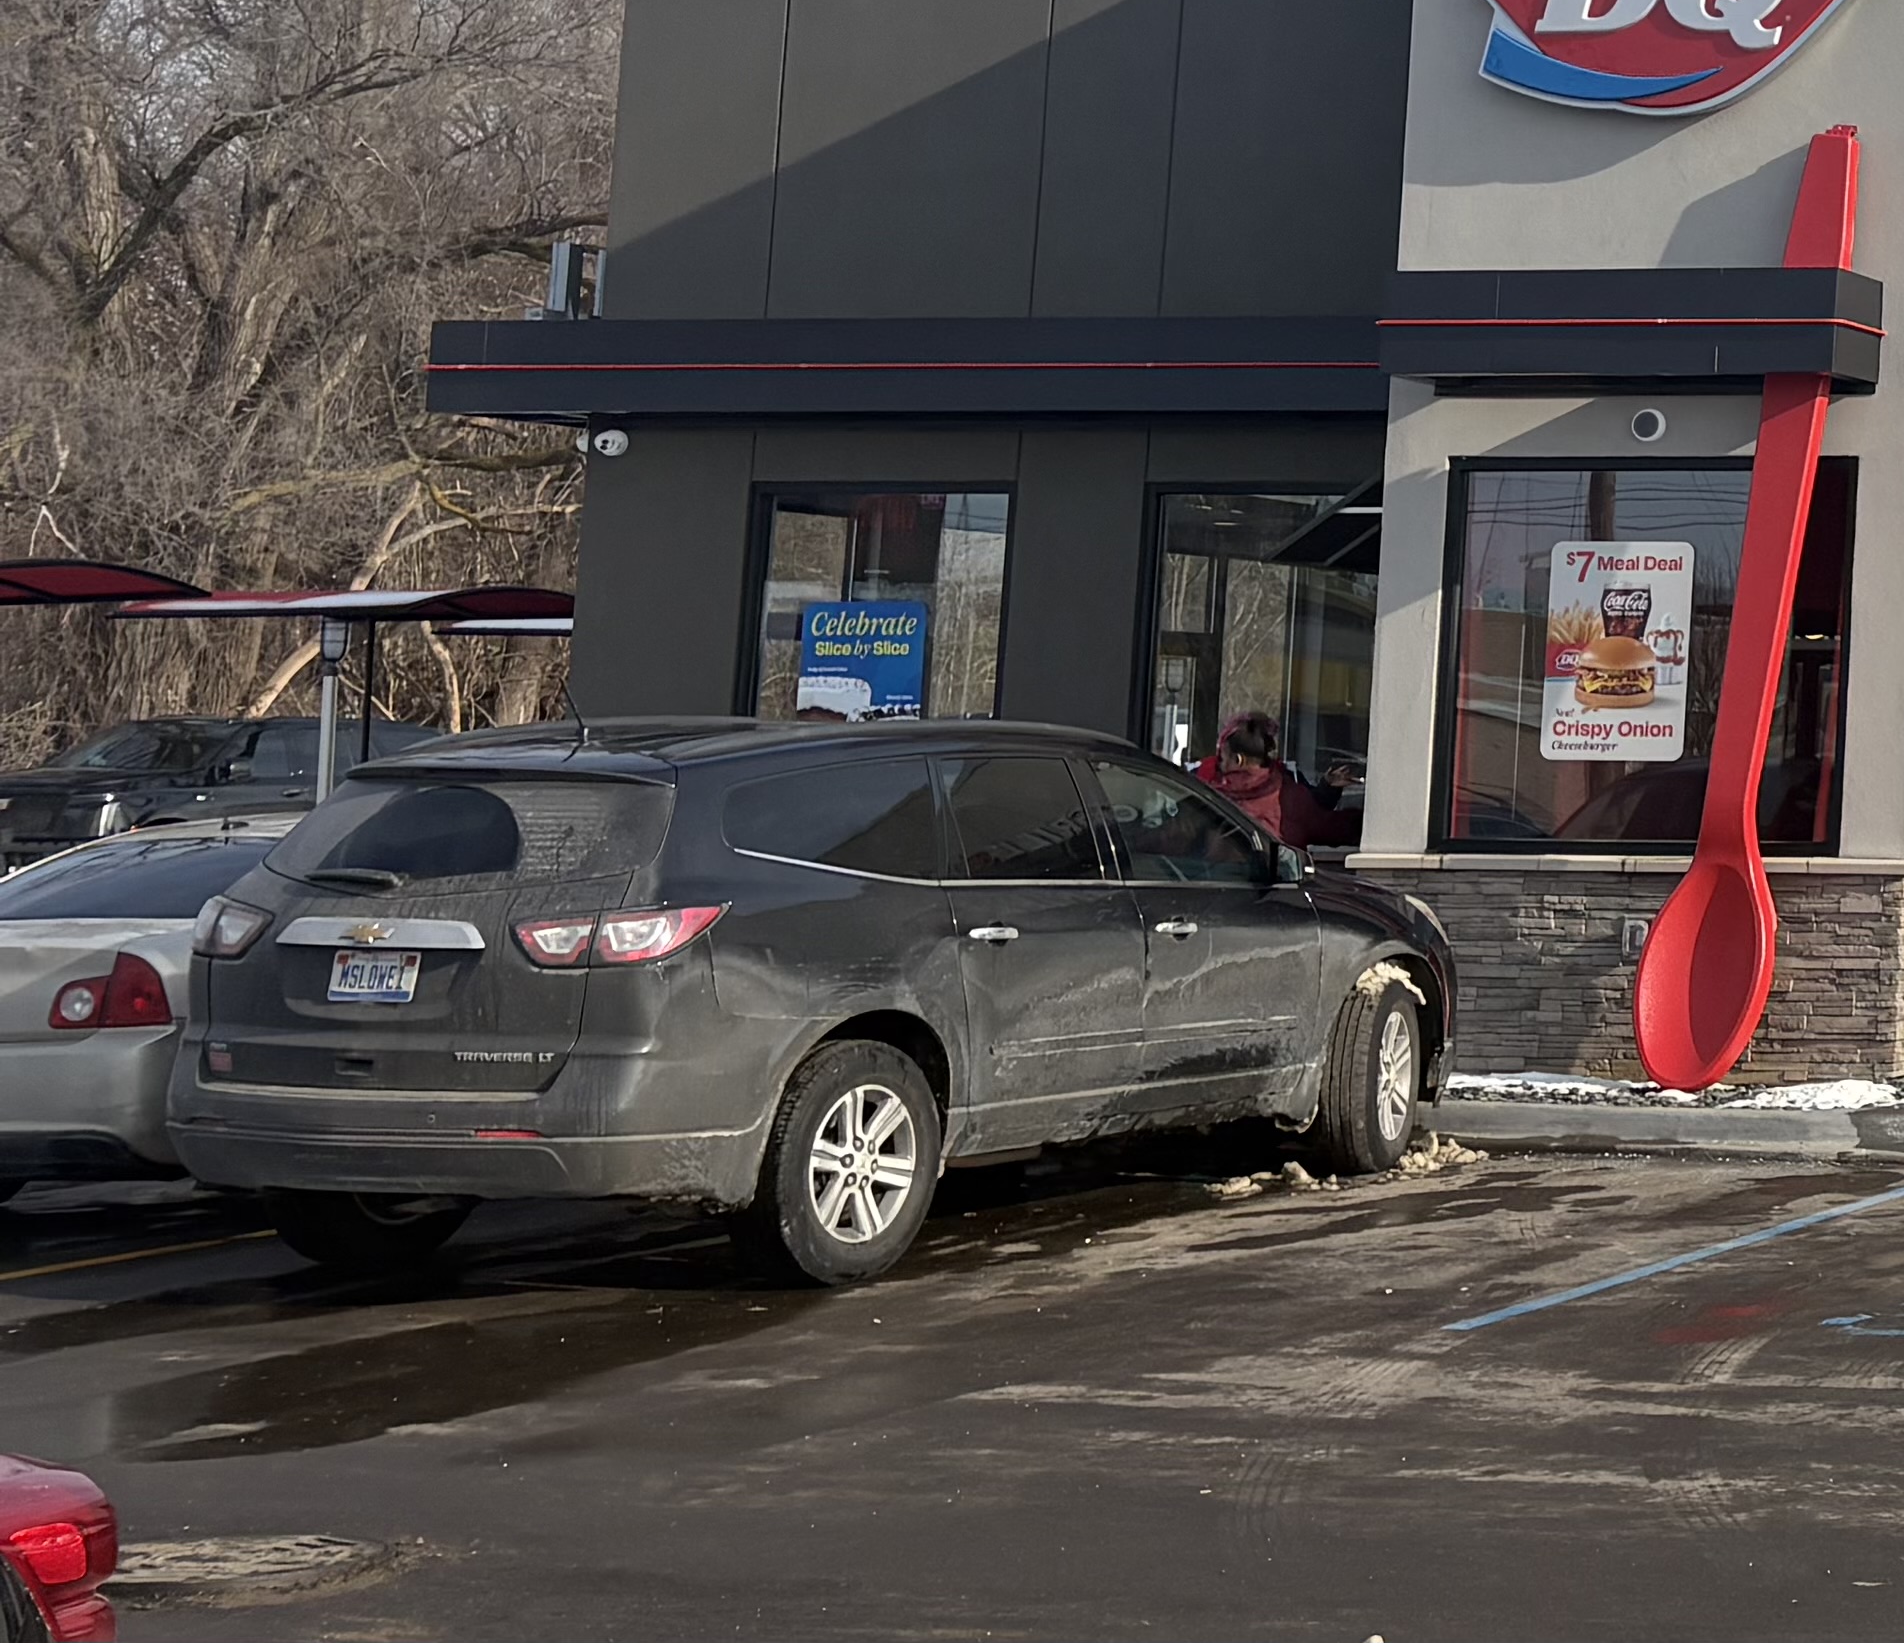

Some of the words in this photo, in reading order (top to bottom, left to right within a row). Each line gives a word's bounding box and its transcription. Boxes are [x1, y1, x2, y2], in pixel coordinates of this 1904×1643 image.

[1566, 551, 1595, 583] $7
[1597, 556, 1640, 571] Meal
[1644, 556, 1683, 571] Deal
[811, 610, 918, 637] Celebrate
[815, 641, 851, 656] Slice
[853, 639, 871, 659] by
[873, 641, 910, 656] Slice
[1553, 721, 1613, 740] Crispy
[1618, 721, 1673, 737] Onion
[1552, 741, 1618, 753] Cheeseburger
[454, 1051, 533, 1064] TRAVERSE
[538, 1052, 555, 1064] LT
